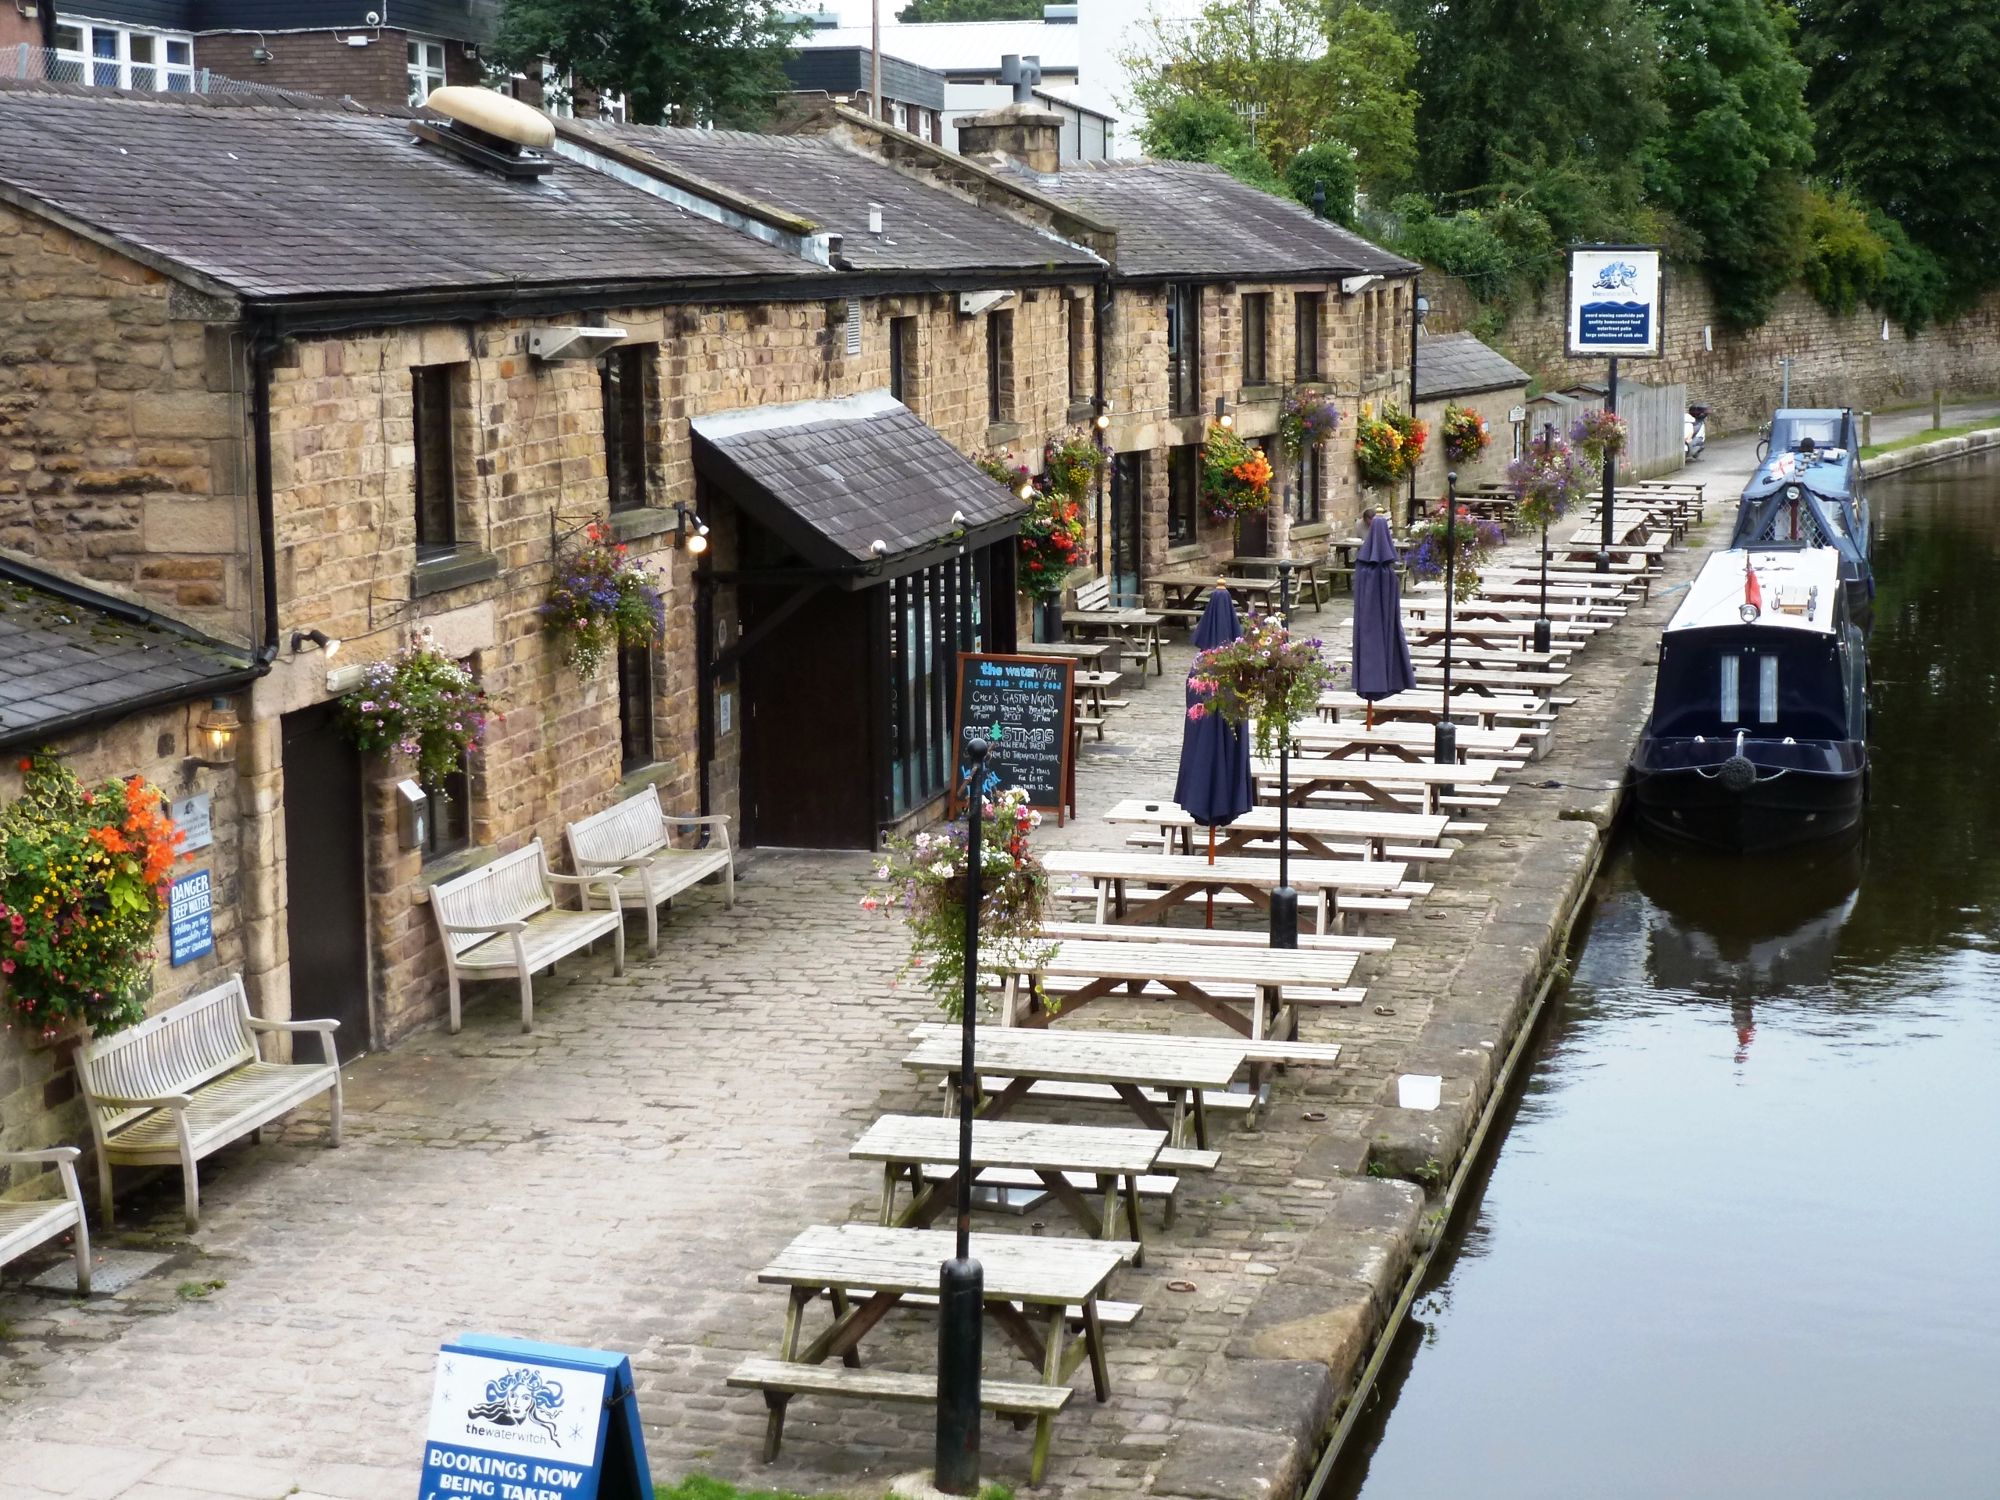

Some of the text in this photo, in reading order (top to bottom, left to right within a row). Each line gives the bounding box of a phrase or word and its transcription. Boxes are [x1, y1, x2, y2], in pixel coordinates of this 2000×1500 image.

[980, 662, 1003, 676] the
[995, 679, 1009, 687] ale
[1019, 680, 1039, 688] fine
[1043, 682, 1062, 690] food
[172, 874, 209, 903] DANGER
[172, 894, 210, 921] DEEP WATER
[429, 1449, 583, 1489] BOOKINGS NOW
[439, 1473, 496, 1496] BEING
